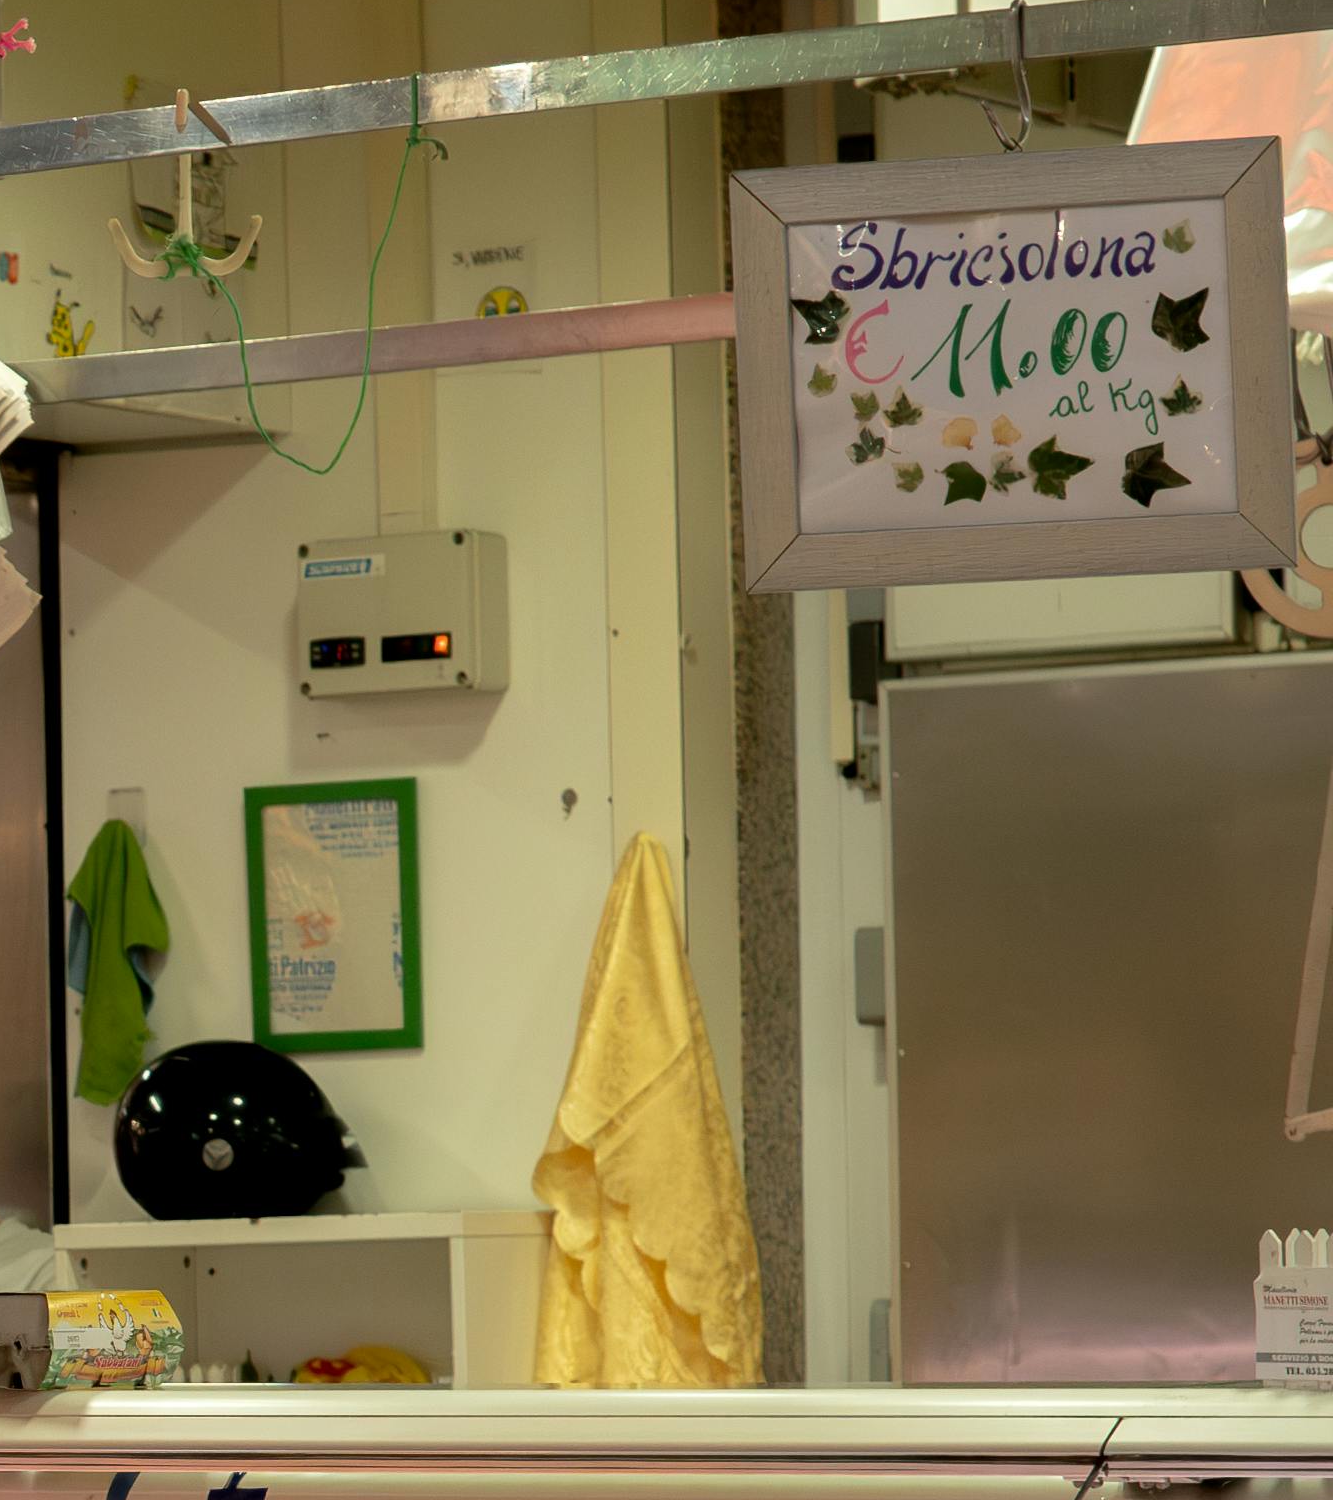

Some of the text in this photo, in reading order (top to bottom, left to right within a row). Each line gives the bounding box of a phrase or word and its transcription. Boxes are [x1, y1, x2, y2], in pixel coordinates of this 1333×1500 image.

[844, 298, 1129, 399] € 11.00
[1048, 380, 1095, 418] al
[1263, 1295, 1329, 1306] MANETTI SIMONE
